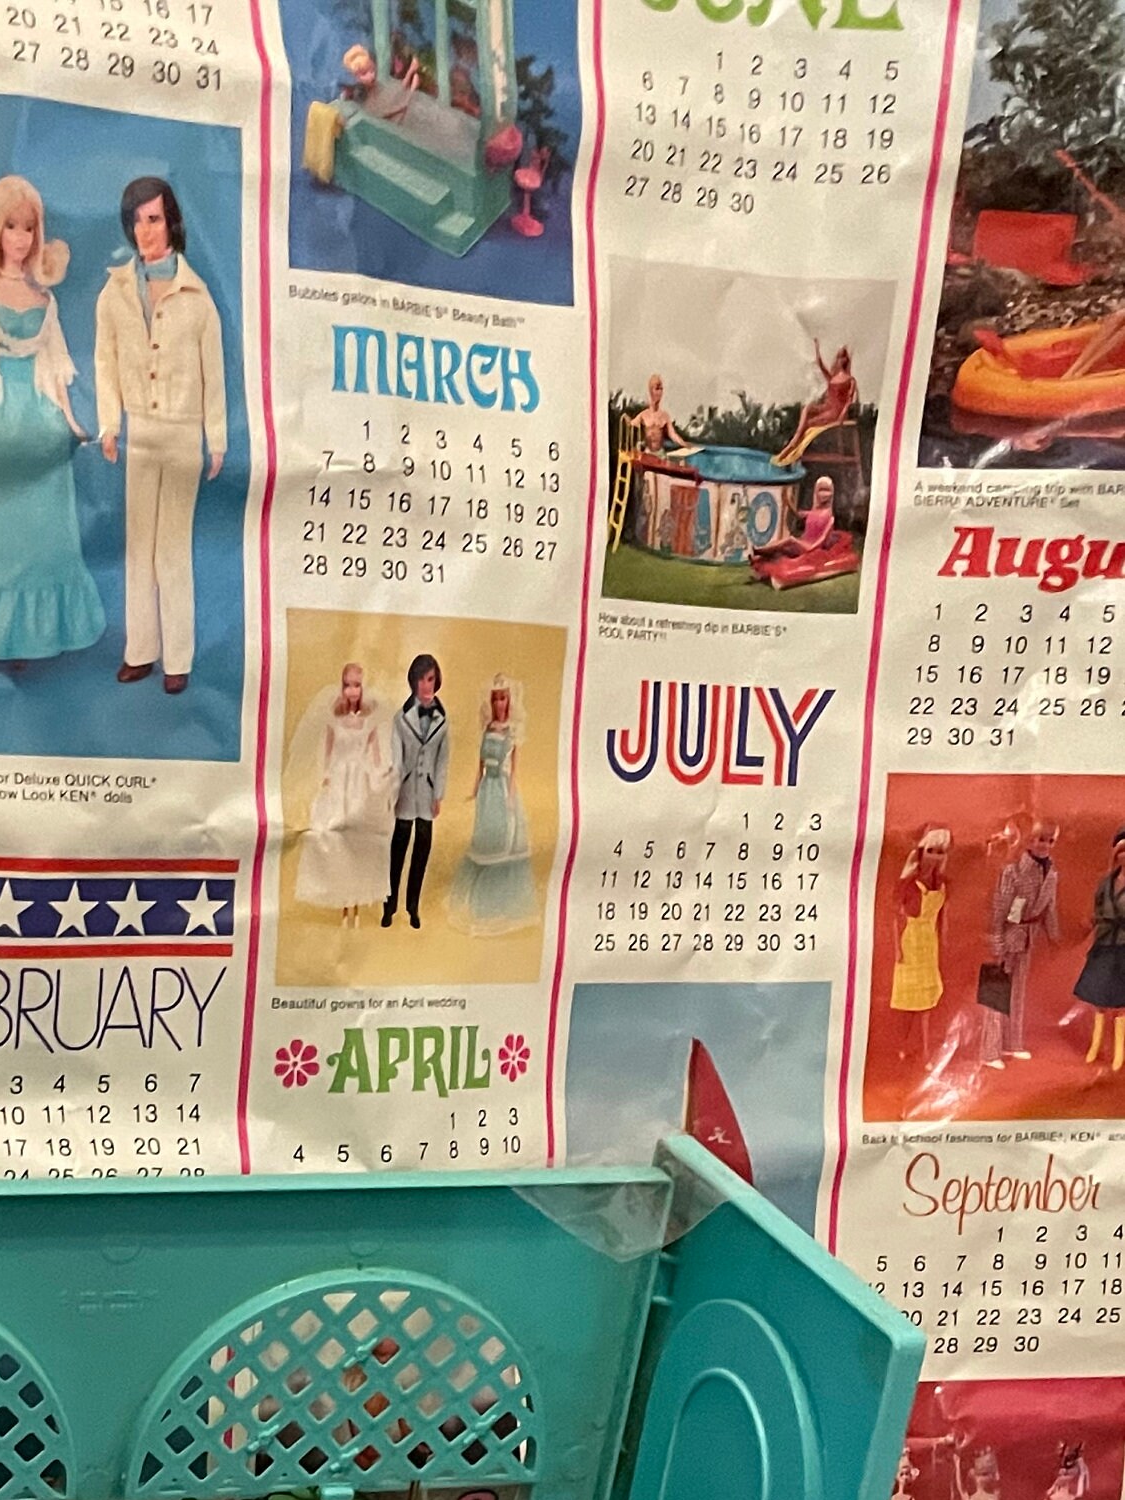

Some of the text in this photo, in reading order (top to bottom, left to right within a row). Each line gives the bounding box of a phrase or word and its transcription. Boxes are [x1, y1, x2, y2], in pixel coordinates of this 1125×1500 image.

[13, 40, 40, 63] 27
[61, 46, 90, 72] 28
[107, 52, 135, 78] 29
[152, 60, 181, 86] 30
[195, 64, 221, 91] 31
[631, 138, 891, 184] 20 21 22 23 24 25 26
[625, 175, 755, 214] 27 28 29 30
[331, 324, 541, 413] MARCH
[308, 485, 559, 528] 14 15 16 17 18 19 20
[303, 520, 557, 561] 21 22 23 24 25 26 27
[916, 664, 1111, 685] 15 16 17 18 19
[909, 696, 1107, 717] 22 23 24 25 26
[606, 680, 836, 787] JULY
[15, 773, 59, 785] Deluxe
[65, 774, 110, 786] QUICK
[23, 789, 54, 800] Look
[104, 792, 132, 803] dolls
[597, 901, 818, 922] 18 19 20 21 22 23 24
[594, 933, 816, 952] 25 26 27 28 29 30 31
[271, 998, 466, 1012] Beautiful gowns for an April wedding
[327, 1026, 491, 1098] APRIL
[9, 1075, 23, 1095] 3
[53, 1074, 66, 1094] 4
[97, 1074, 111, 1094] 5
[144, 1073, 158, 1093] 6
[189, 1073, 202, 1094] 7
[0, 1106, 25, 1126] 10
[42, 1104, 65, 1124] 11
[86, 1104, 111, 1124] 12
[132, 1103, 158, 1123] 13
[176, 1103, 201, 1123] 14
[292, 1135, 521, 1163] 4 5 6 7 8 9 10
[997, 1134, 1012, 1142] for
[903, 1152, 1101, 1235] September
[936, 1307, 1122, 1327] 21 22 23 24 25
[933, 1335, 1040, 1354] 28 29 30
